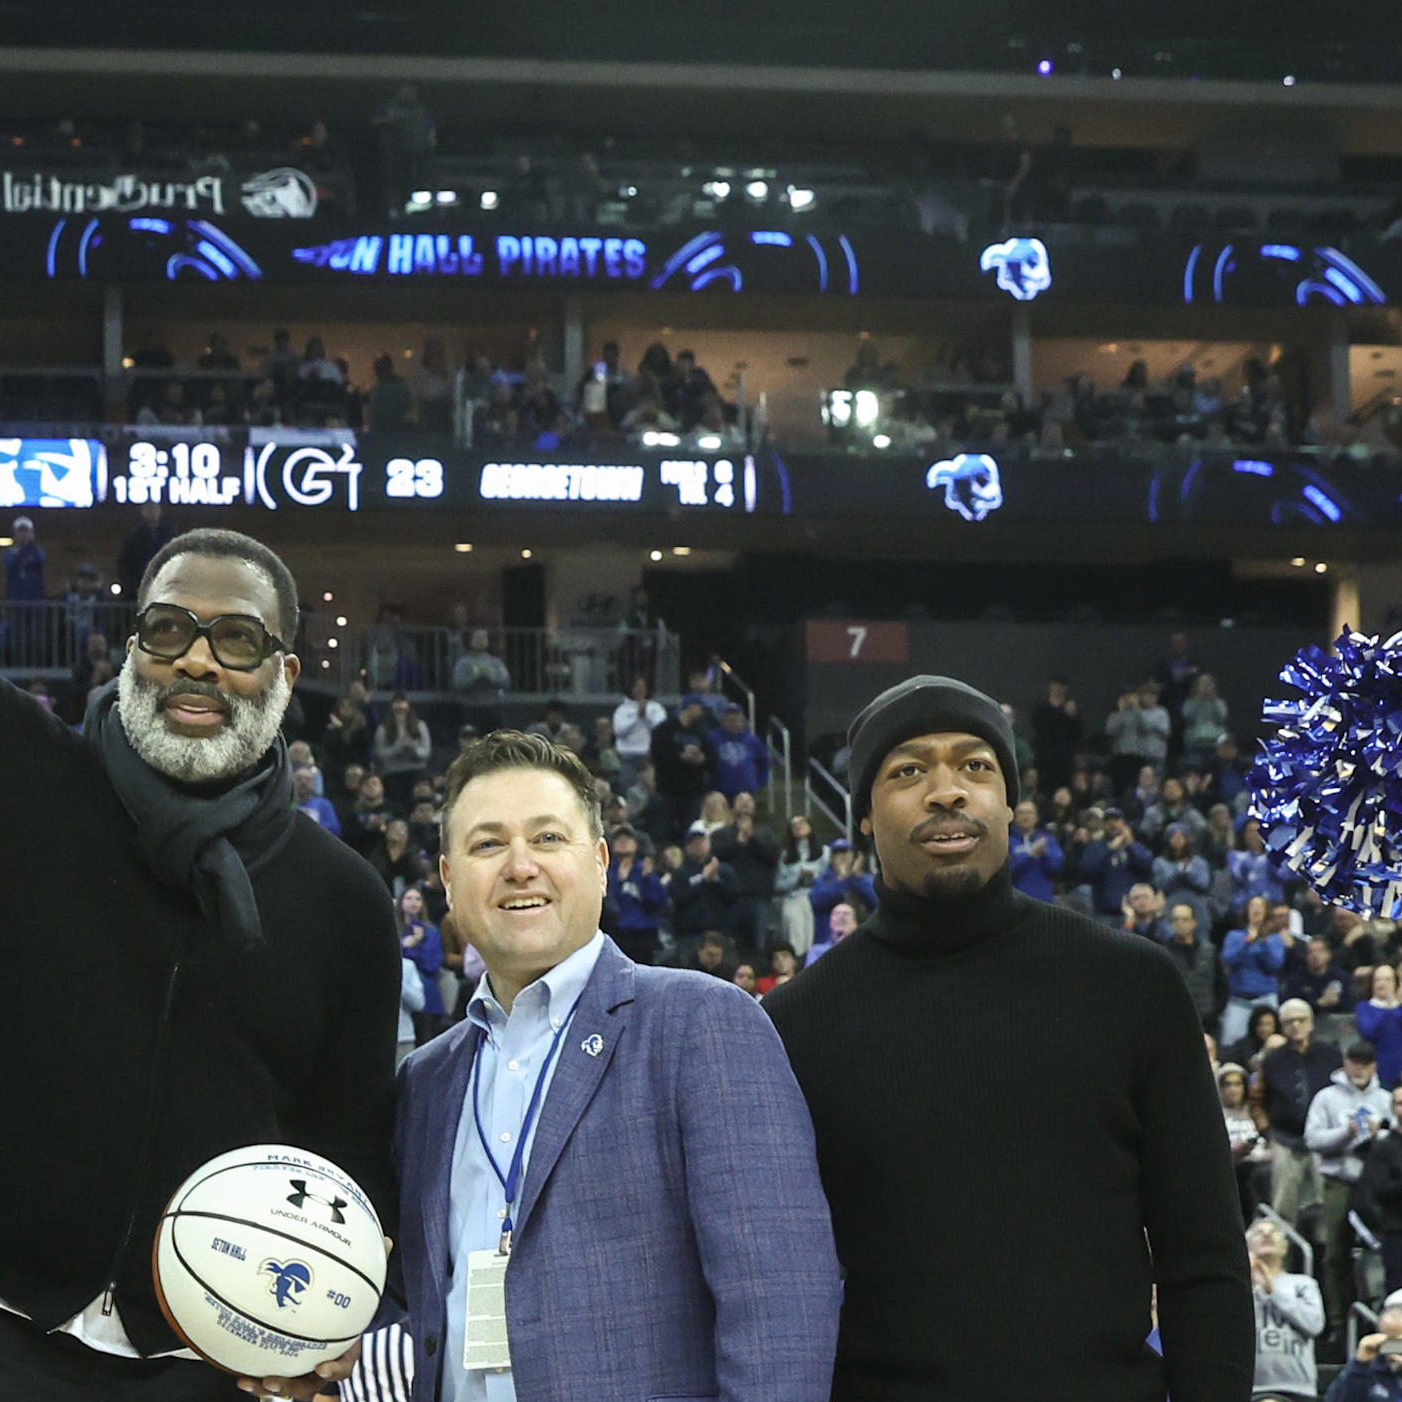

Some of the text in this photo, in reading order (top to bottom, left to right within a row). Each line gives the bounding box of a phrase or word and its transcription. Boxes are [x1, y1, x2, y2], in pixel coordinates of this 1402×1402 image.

[387, 234, 484, 276] HALL
[497, 235, 647, 278] PIRATES
[129, 442, 221, 478] 3:10
[169, 476, 241, 504] HALF
[386, 459, 444, 498] 23
[847, 626, 867, 657] 7
[270, 1208, 352, 1247] UNDER ARMOUR
[326, 1288, 352, 1310] #00
